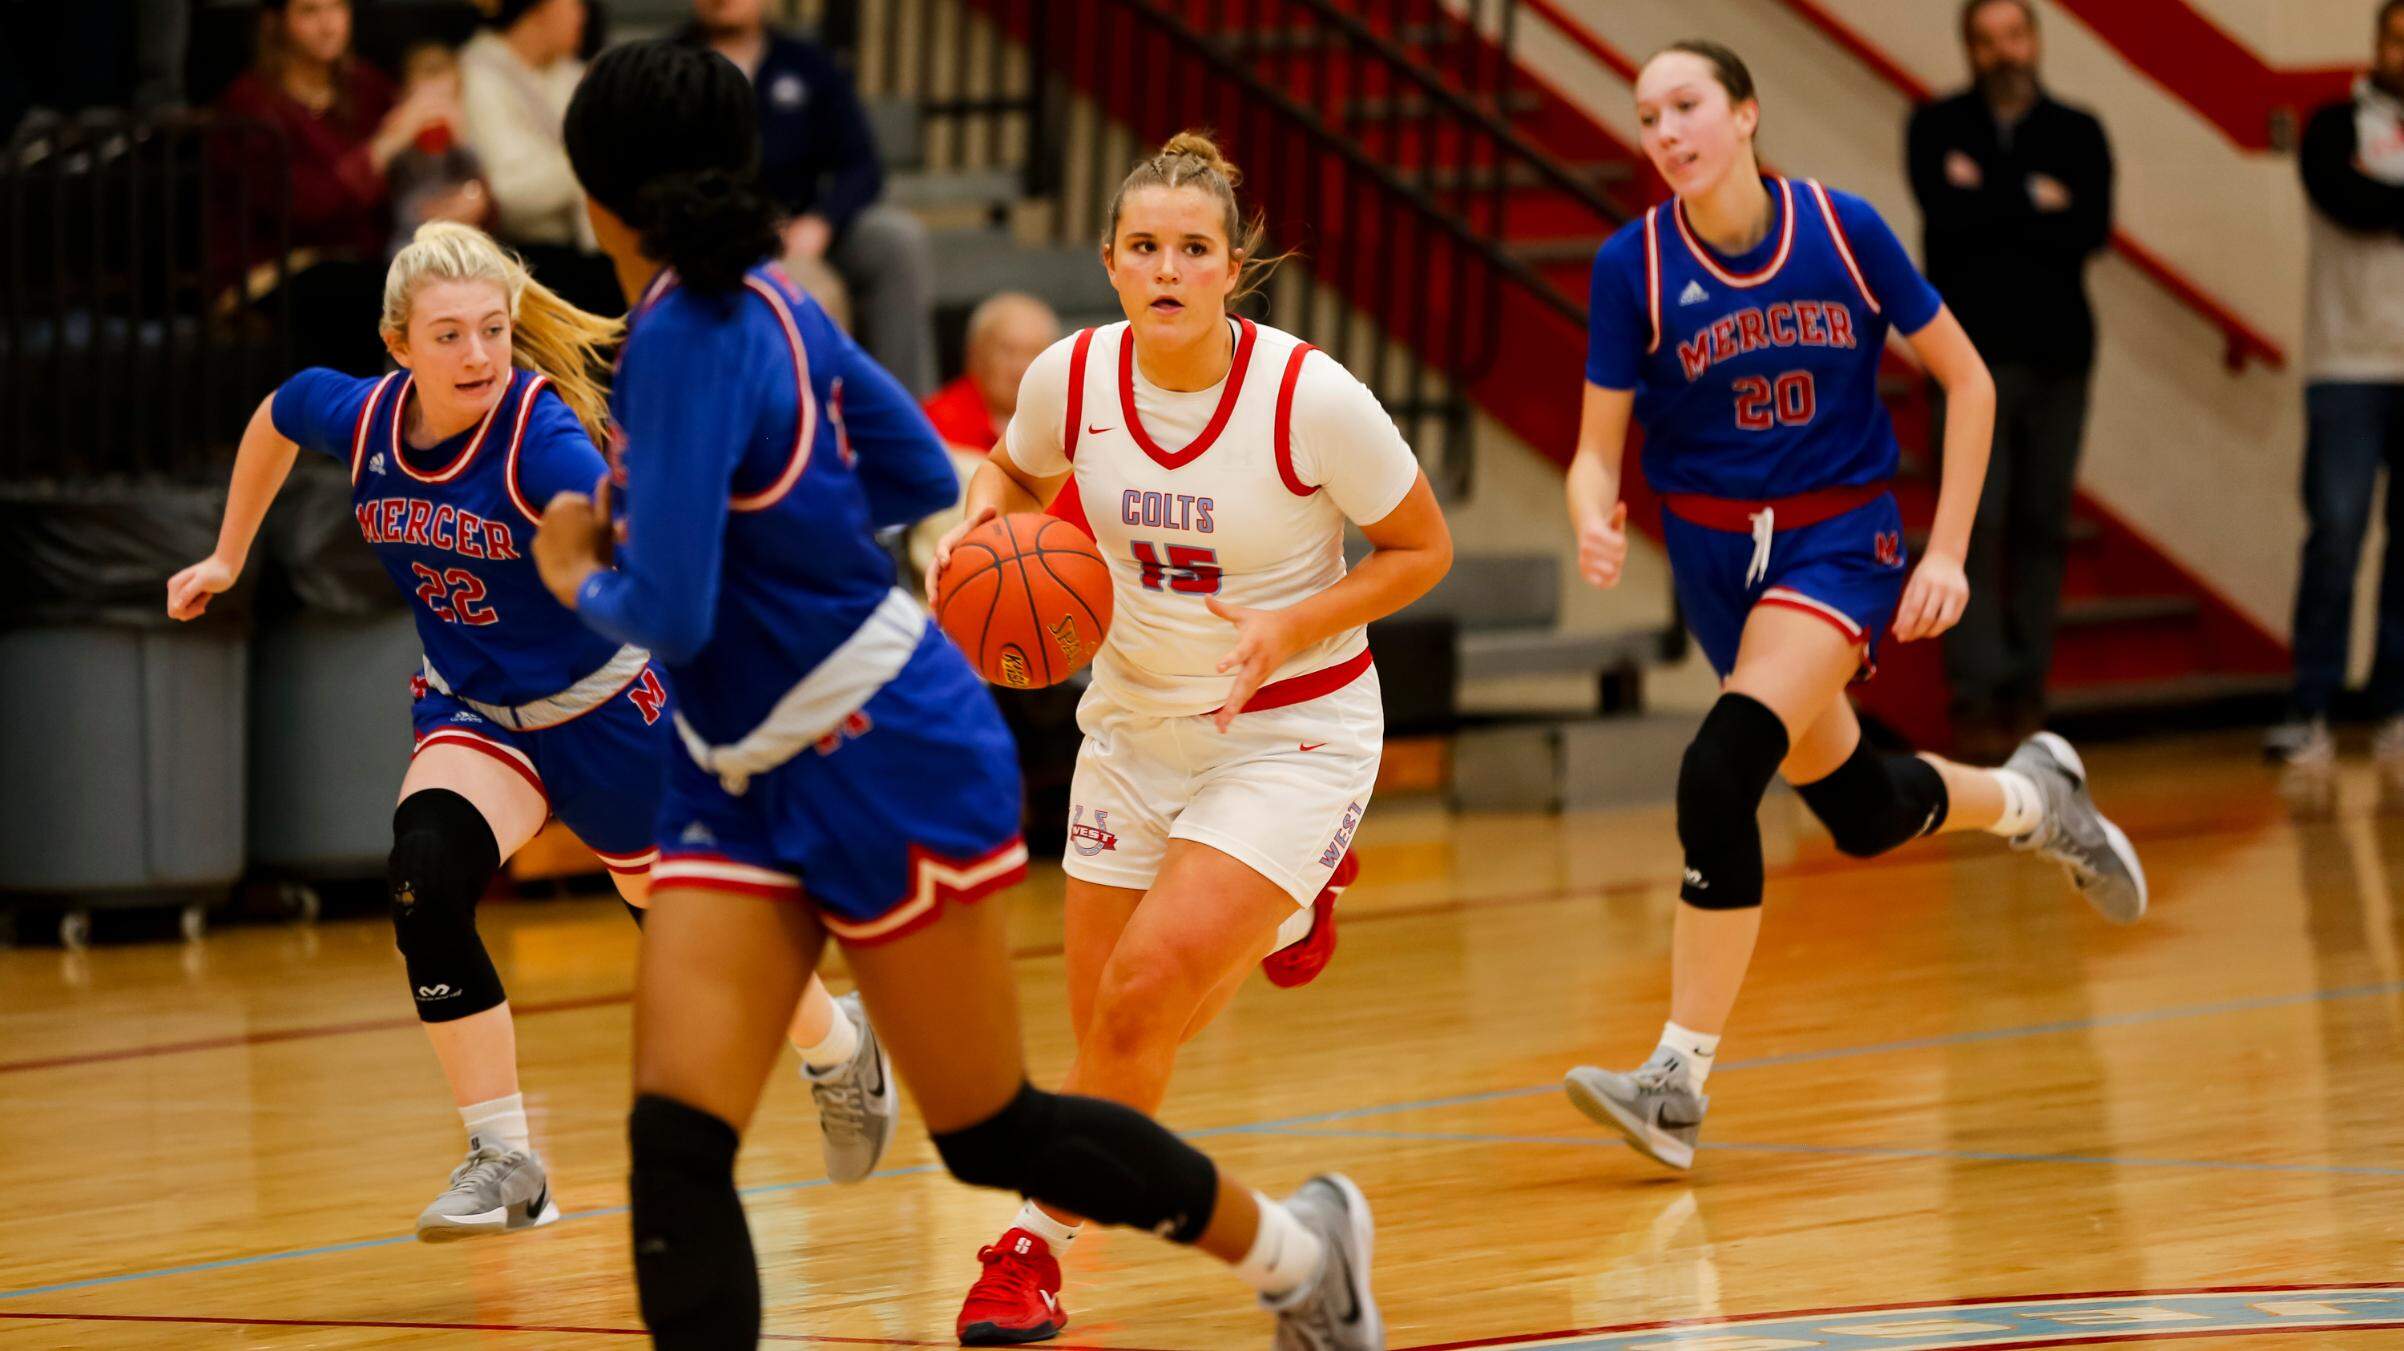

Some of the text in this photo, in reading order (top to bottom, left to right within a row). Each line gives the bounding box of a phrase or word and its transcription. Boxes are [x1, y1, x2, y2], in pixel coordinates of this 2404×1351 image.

[1676, 300, 1857, 384] MERCER
[1731, 368, 1817, 432] 20
[355, 498, 522, 561] MERCER
[1121, 488, 1215, 534] COLTS
[411, 560, 500, 627] 22
[1129, 540, 1223, 597] 15
[627, 667, 668, 727] M
[1319, 801, 1363, 869] WEST
